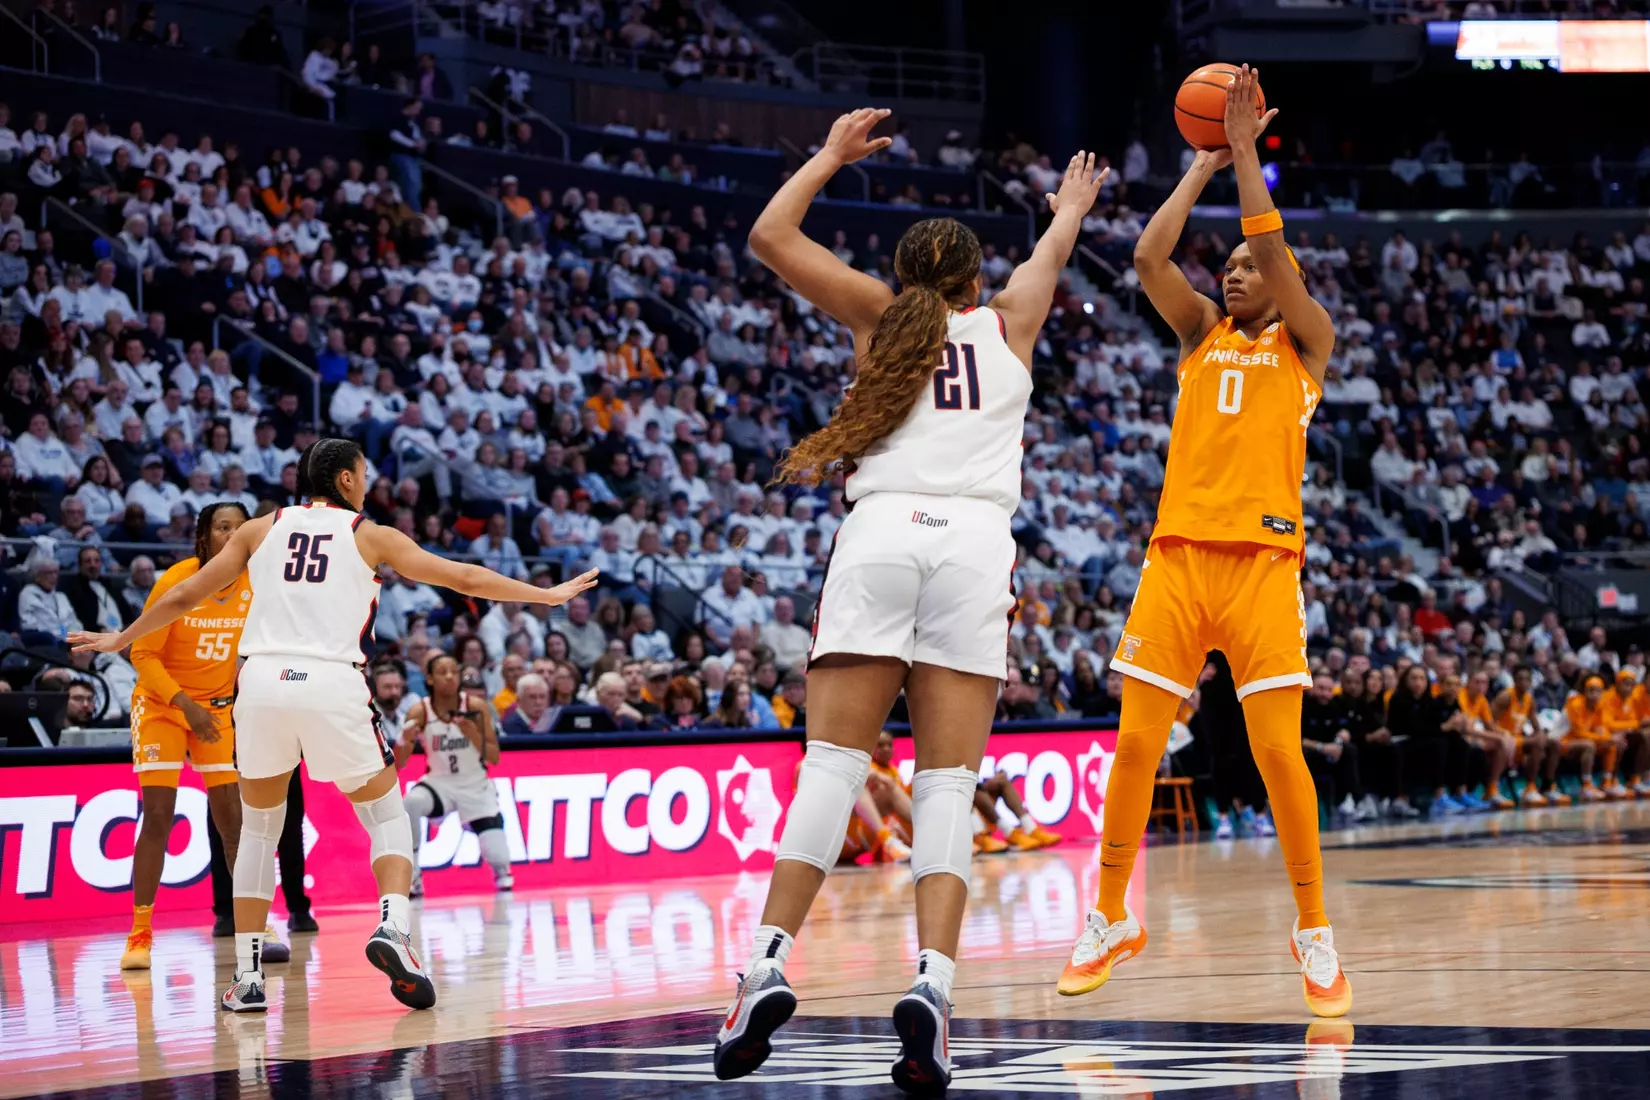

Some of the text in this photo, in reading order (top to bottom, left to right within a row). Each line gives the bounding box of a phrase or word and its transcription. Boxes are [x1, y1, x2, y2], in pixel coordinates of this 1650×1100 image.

[933, 342, 981, 411] 21
[1217, 368, 1244, 415] 0
[911, 510, 949, 528] UConn
[283, 532, 333, 583] 35
[183, 615, 246, 629] TENNESSE
[195, 632, 234, 661] 55
[279, 668, 308, 682] UConn
[448, 755, 459, 774] 2
